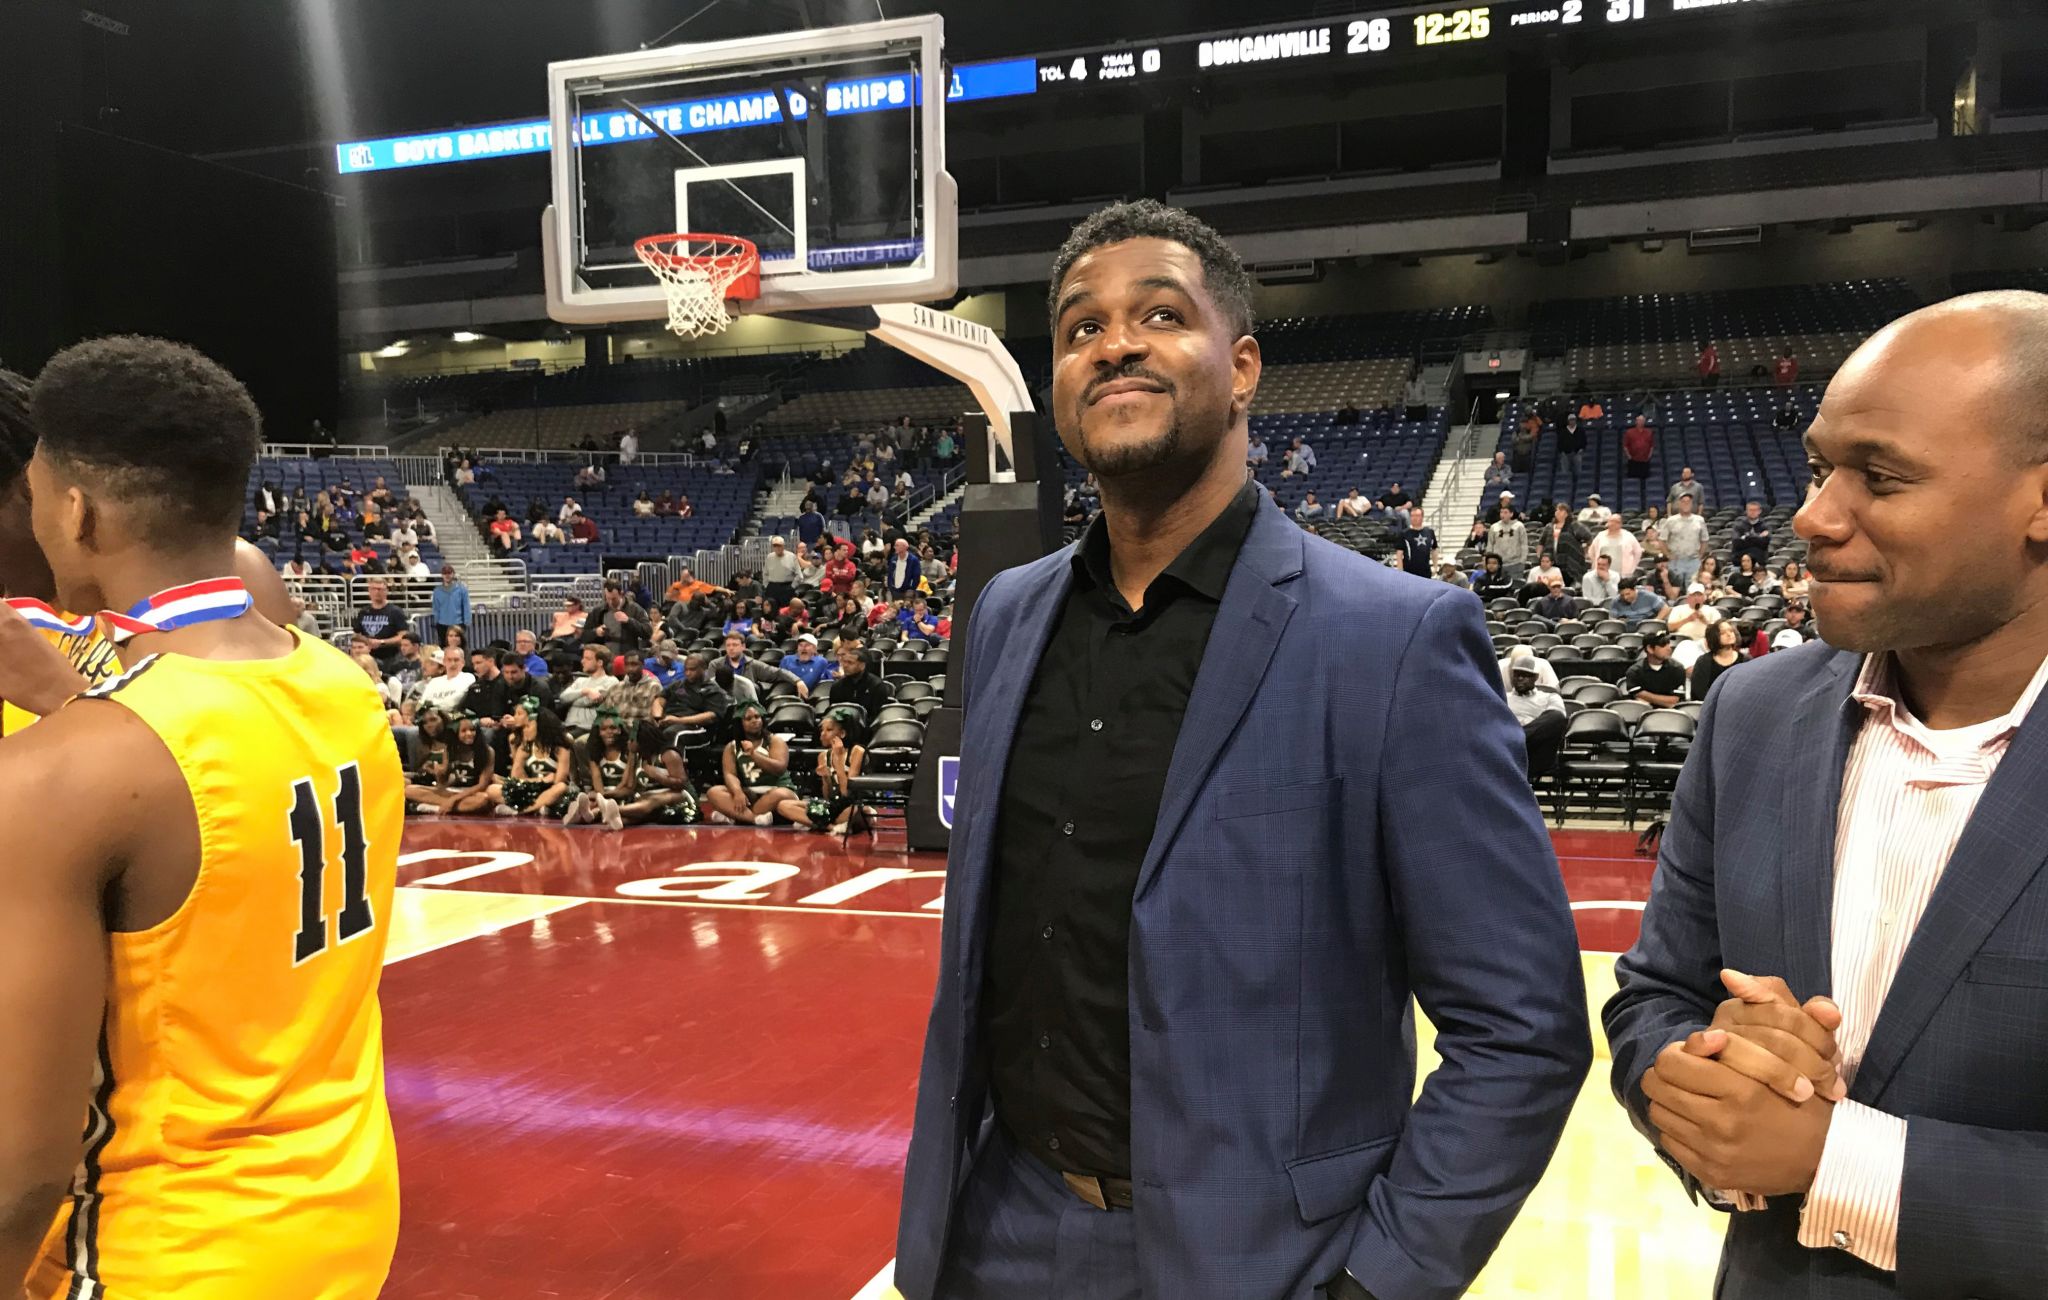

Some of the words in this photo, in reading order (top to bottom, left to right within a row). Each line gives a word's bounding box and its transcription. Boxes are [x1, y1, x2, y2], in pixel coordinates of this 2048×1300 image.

[1101, 52, 1134, 67] TEAM
[1142, 49, 1160, 73] 0
[1198, 28, 1331, 68] DUNCANVILLE
[1347, 18, 1390, 54] 26
[1413, 7, 1490, 46] 12:25
[1510, 10, 1559, 26] PERIOD
[1562, 0, 1582, 24] 2
[1040, 65, 1065, 82] TOL
[1069, 57, 1087, 81] 4
[393, 135, 453, 163] BOYS
[609, 107, 683, 139] STATE
[689, 80, 906, 129] CHAMPOSHIPS
[913, 306, 935, 328] SAN
[942, 315, 988, 345] ANTONIO
[287, 760, 375, 968] 11
